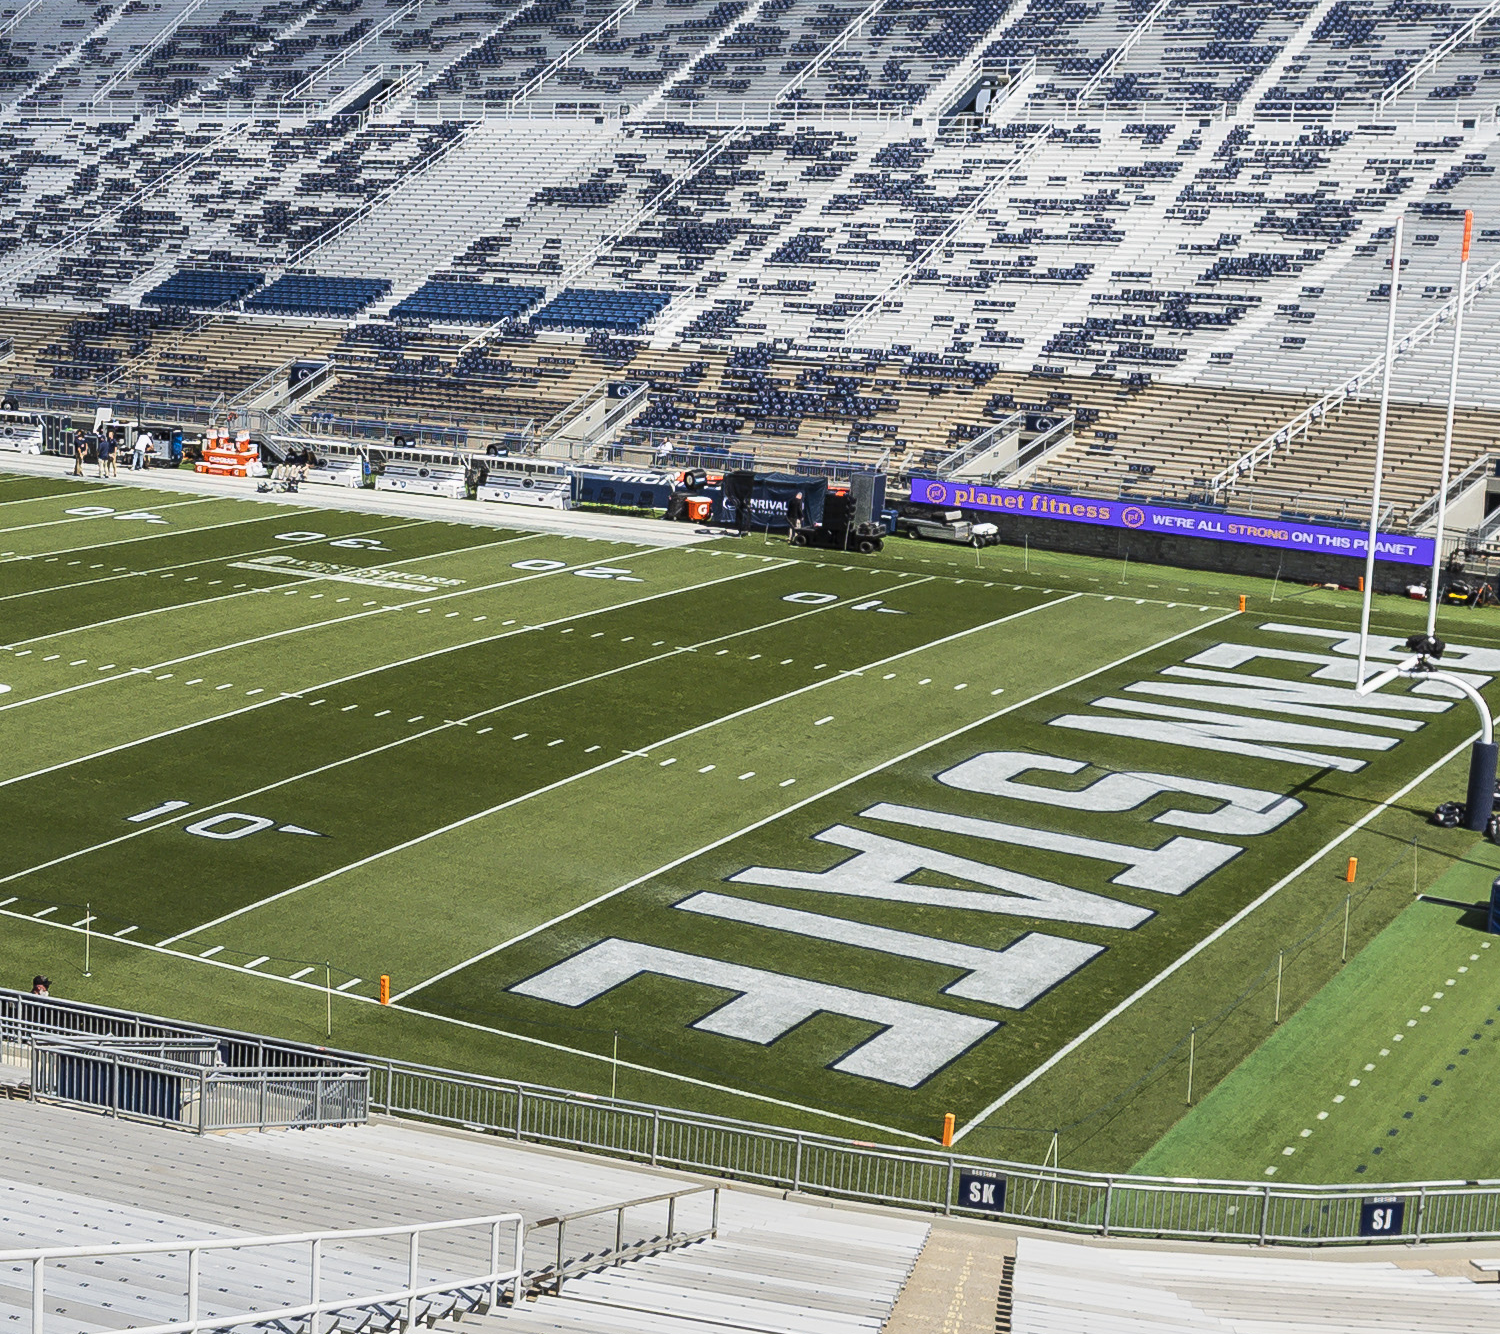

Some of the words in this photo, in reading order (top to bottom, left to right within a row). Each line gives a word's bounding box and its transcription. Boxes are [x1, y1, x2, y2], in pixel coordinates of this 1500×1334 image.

[697, 504, 708, 516] G
[954, 488, 1024, 510] planet
[1030, 495, 1110, 520] fitness
[1152, 515, 1195, 529] WE'RE
[1197, 521, 1225, 533] ALL
[1228, 523, 1289, 540] STRONG
[1291, 531, 1315, 543] ON
[1316, 533, 1351, 548] THIS
[1353, 539, 1418, 556] PLANET
[127, 800, 274, 840] 10
[507, 749, 1307, 1090] STATE
[970, 1181, 996, 1205] SK
[1372, 1208, 1393, 1231] SJ
